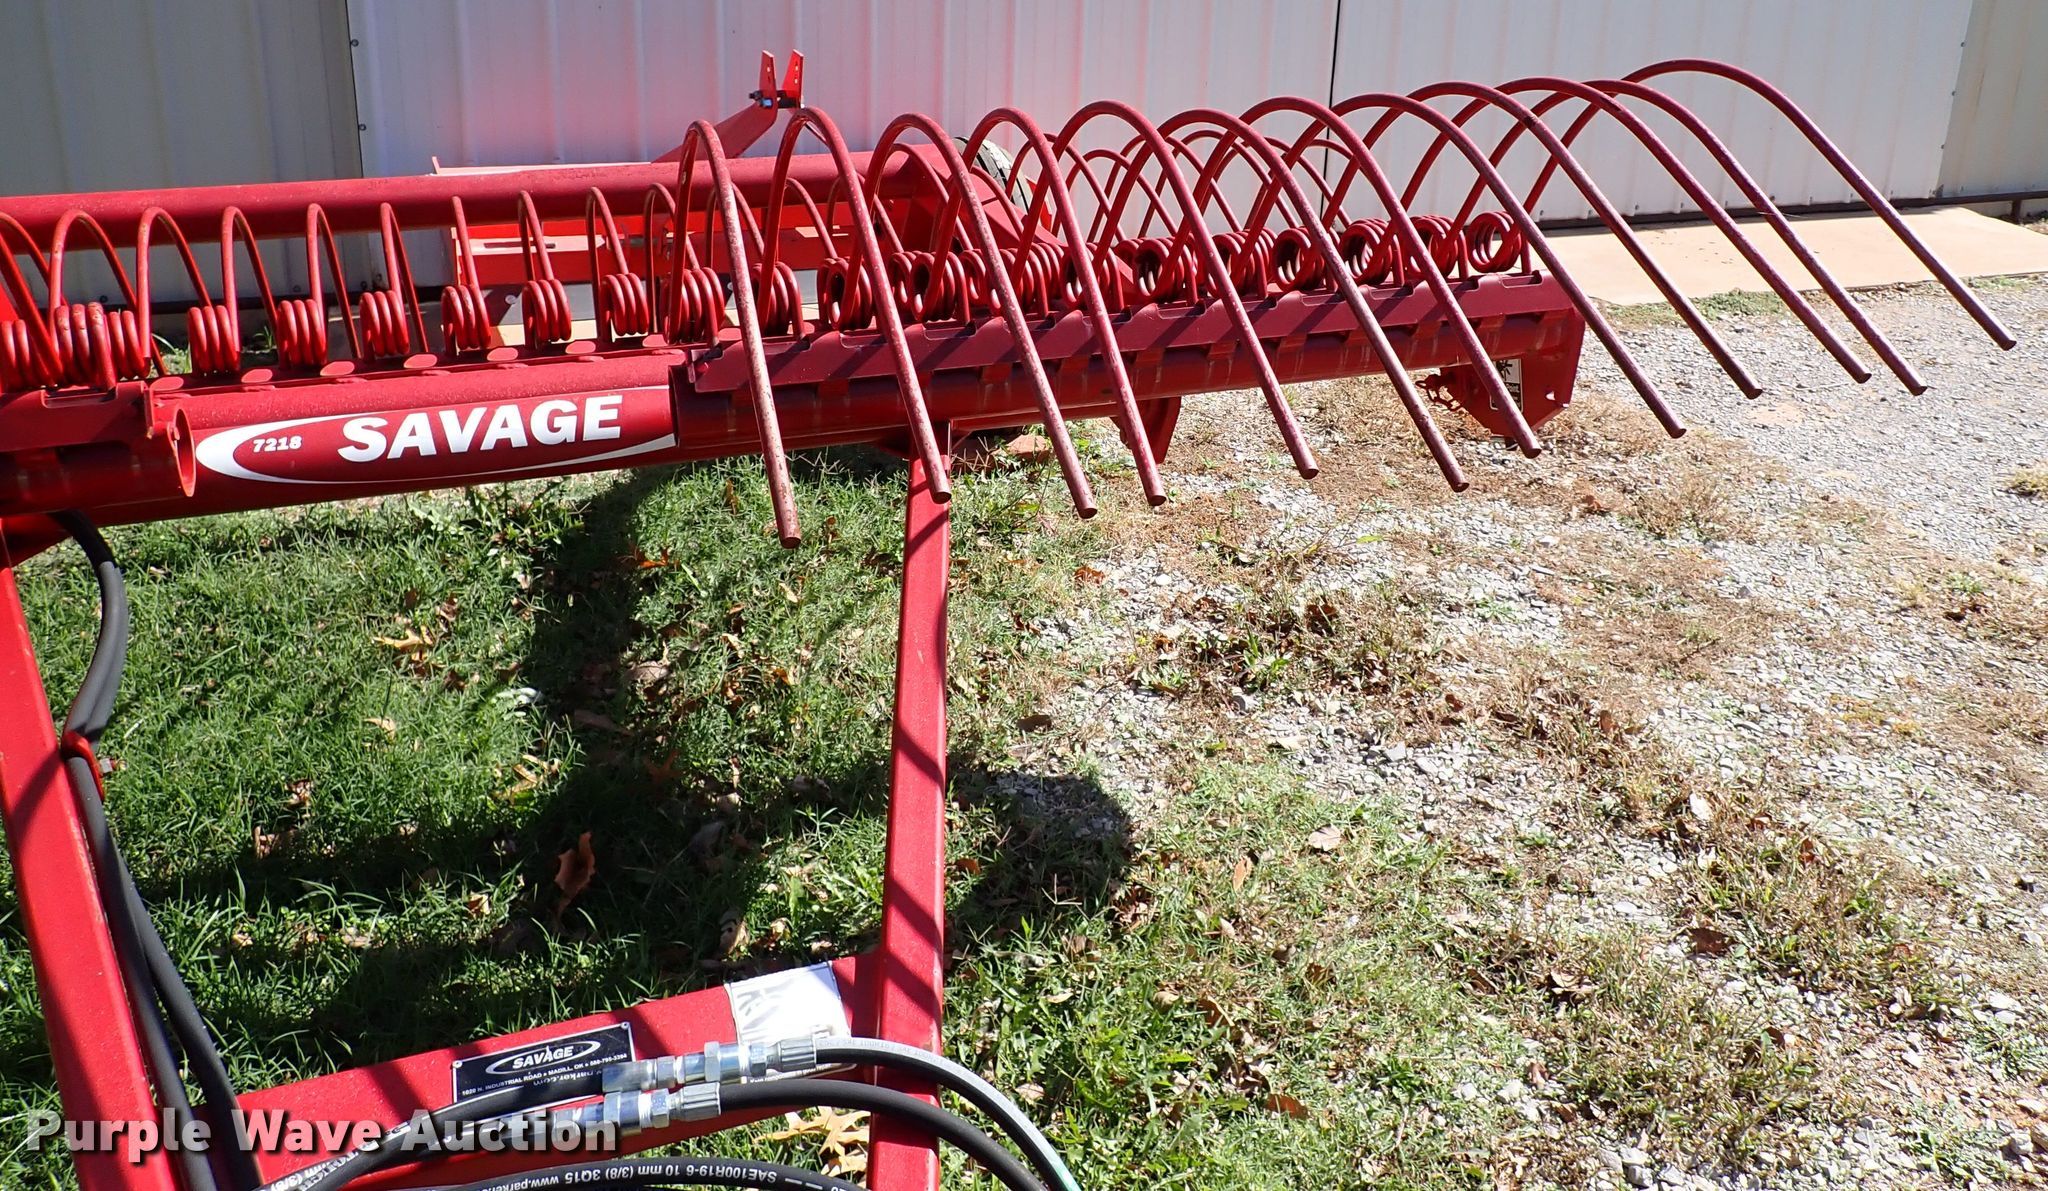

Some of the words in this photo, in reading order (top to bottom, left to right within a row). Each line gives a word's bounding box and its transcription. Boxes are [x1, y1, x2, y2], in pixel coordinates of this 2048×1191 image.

[337, 395, 623, 463] SAVAGE
[253, 435, 302, 453] 7218
[512, 1045, 574, 1069] SAVAGE
[485, 1077, 522, 1090] INDUSTRIAL
[523, 1072, 542, 1081] ROAD
[564, 1169, 601, 1184] 3Q15
[605, 1166, 634, 1180] (3/8)
[637, 1164, 662, 1176] mm
[665, 1164, 681, 1177] 10
[686, 1164, 778, 1183] SAE100R19-6
